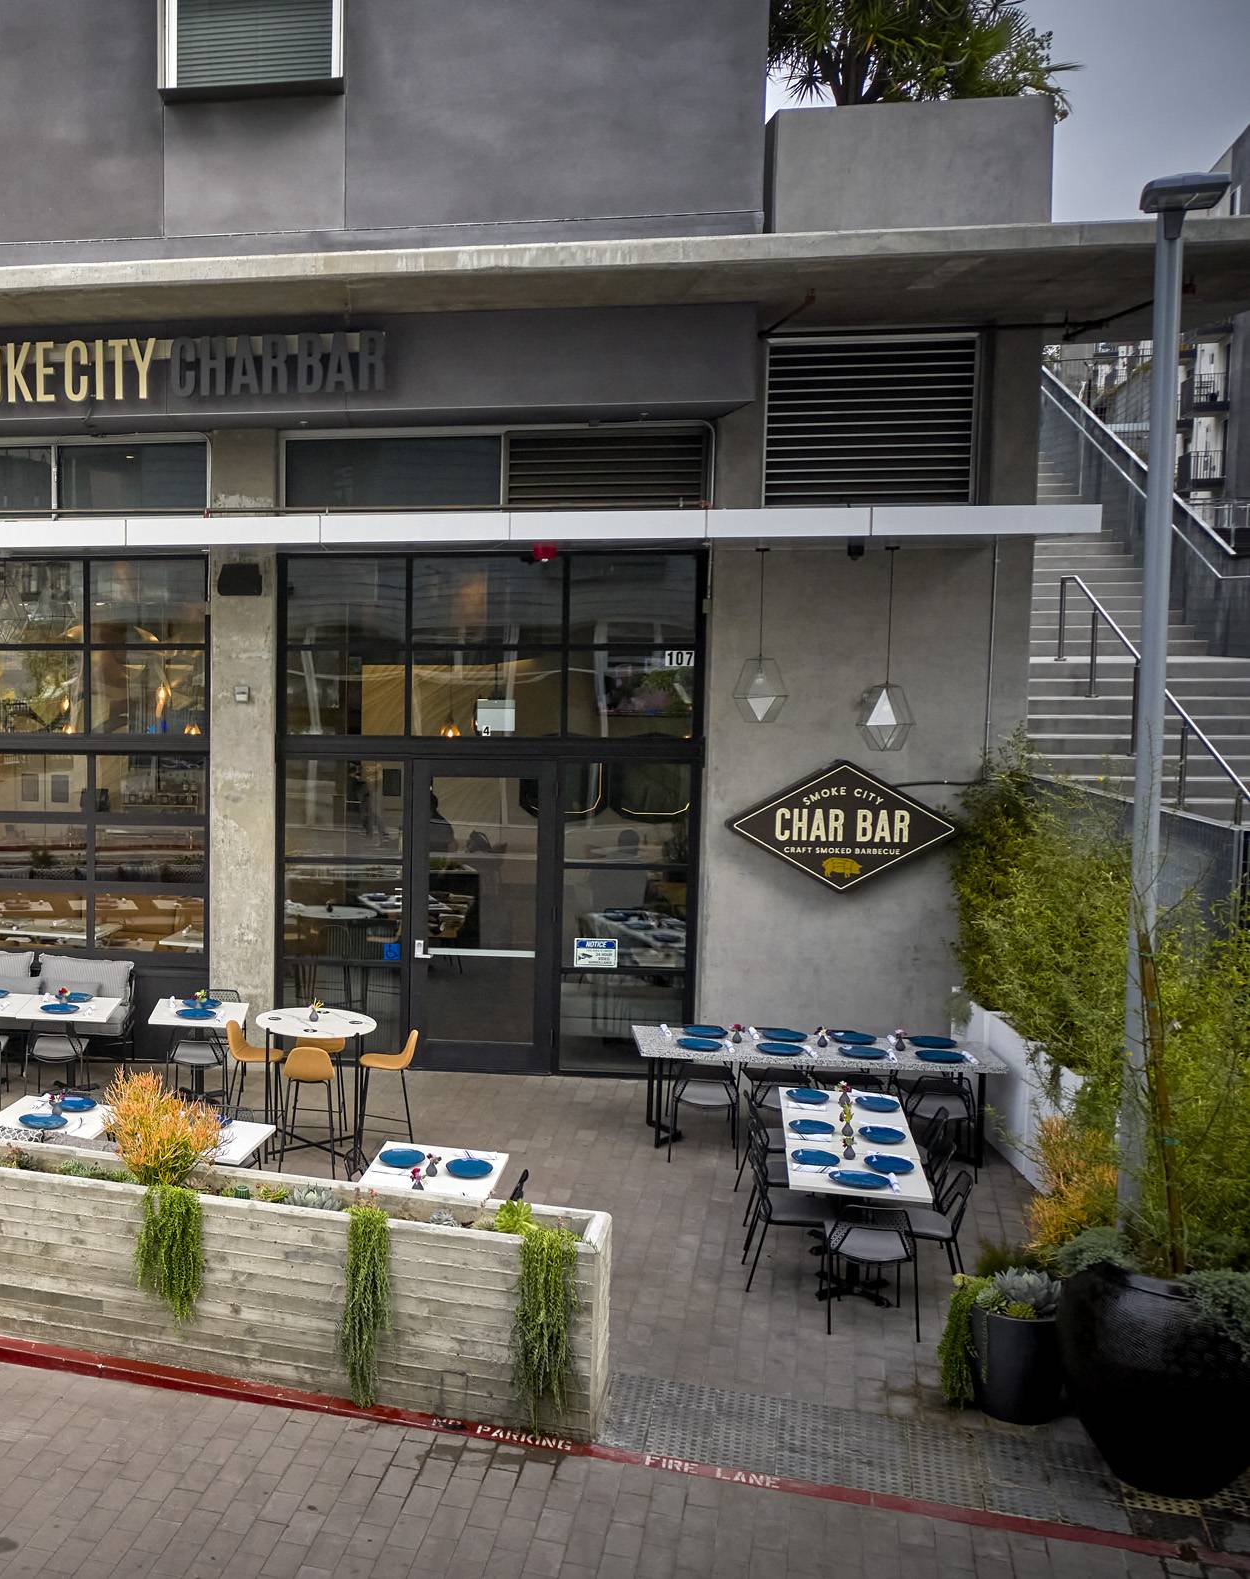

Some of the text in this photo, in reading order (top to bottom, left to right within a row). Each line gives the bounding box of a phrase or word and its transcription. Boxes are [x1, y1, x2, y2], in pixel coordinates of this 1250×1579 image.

[64, 337, 156, 402] CITY
[170, 333, 290, 398] CHAR
[297, 330, 386, 394] BAR
[667, 651, 693, 666] 107
[483, 726, 490, 736] 4
[802, 787, 884, 806] SMOKE CITY
[775, 807, 910, 843] CHAR BAR
[783, 846, 812, 854] CRAFT
[815, 847, 852, 855] SMOKED
[477, 1424, 573, 1451] PARKING
[644, 1455, 780, 1489] FIRE LANE
